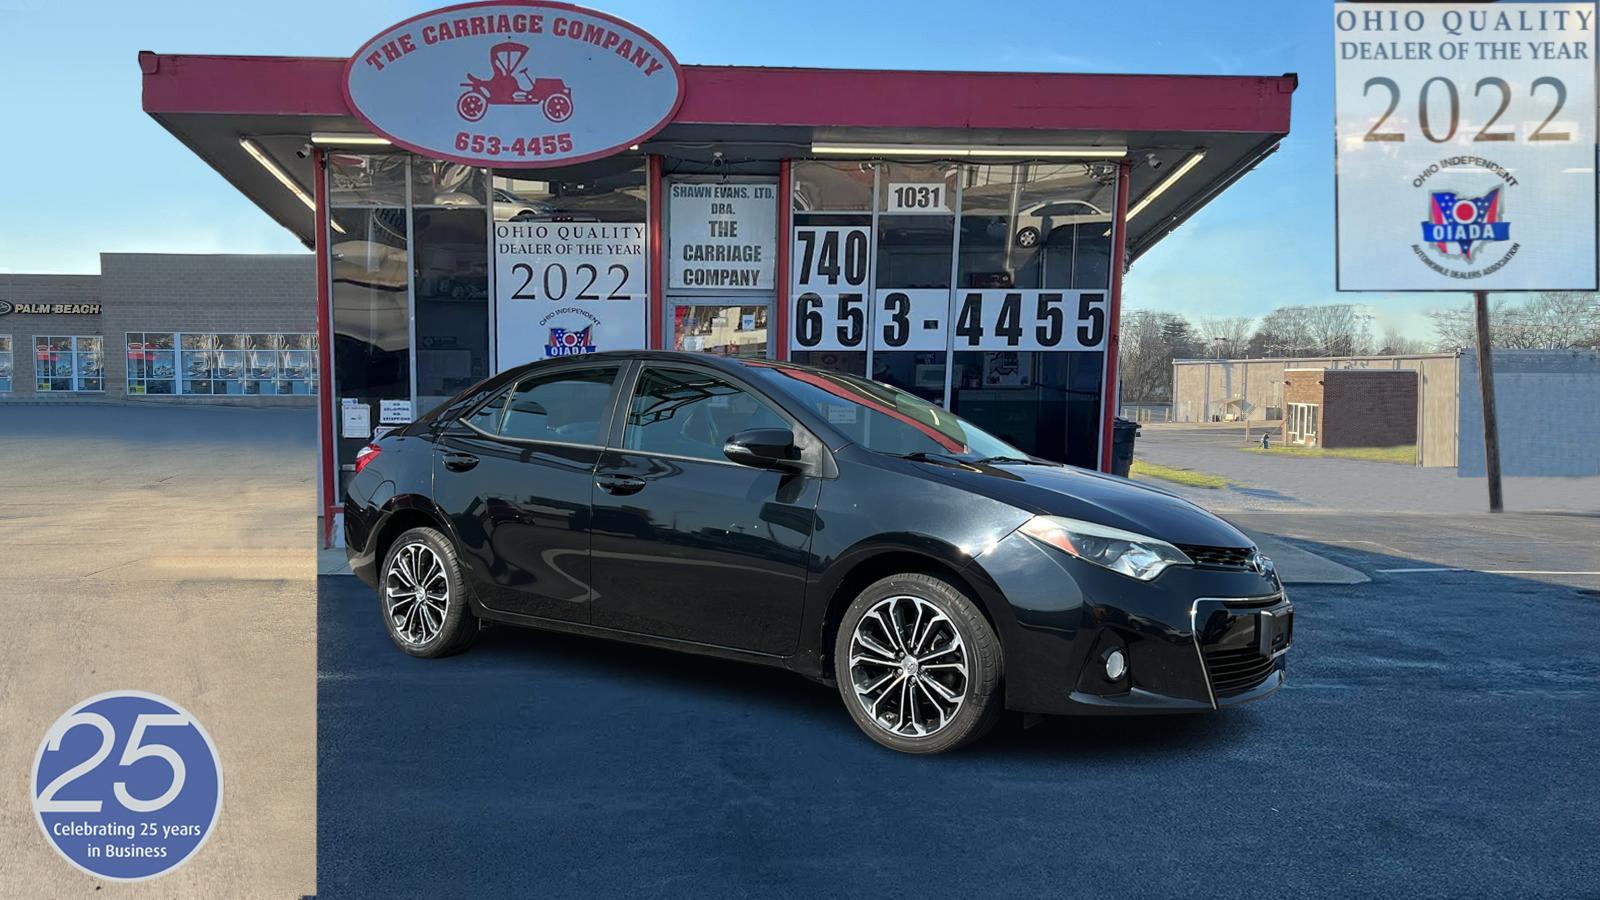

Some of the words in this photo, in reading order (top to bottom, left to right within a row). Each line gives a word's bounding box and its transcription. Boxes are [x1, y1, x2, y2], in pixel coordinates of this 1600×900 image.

[1336, 10, 1425, 31] OHIO
[1442, 10, 1593, 35] QUALITY
[366, 33, 416, 72] THE
[421, 14, 544, 46] CARRIAGE
[552, 17, 664, 77] COMPANY
[1340, 42, 1433, 60] DEALER
[1439, 41, 1469, 60] OF
[1475, 41, 1522, 59] THE
[1528, 41, 1589, 59] YEAR
[1363, 76, 1571, 143] 2022
[455, 132, 573, 156] 653-4455
[1412, 164, 1439, 188] OHIO
[1439, 155, 1519, 187] INDEPENDENT
[672, 186, 712, 199] SHAWN
[754, 186, 774, 199] LTD.
[894, 186, 941, 208] 1031
[711, 203, 735, 215] DBA.
[497, 226, 548, 239] OHIO
[558, 225, 644, 241] QUALITY
[708, 220, 737, 237] THE
[1432, 224, 1496, 241] OIADA
[499, 243, 552, 255] DEALER
[555, 243, 573, 255] OF
[576, 243, 603, 255] THE
[606, 243, 641, 255] YEAR
[683, 244, 762, 262] CARRIAGE
[797, 230, 868, 286] 740
[511, 263, 631, 301] 2022
[683, 268, 760, 286] COMPANY
[1450, 268, 1482, 280] DEALERS
[14, 303, 51, 314] PALM
[54, 304, 100, 314] BEACH
[539, 312, 555, 326] OHIO
[555, 307, 601, 326] INDEPENDENT
[551, 346, 587, 356] OIADA
